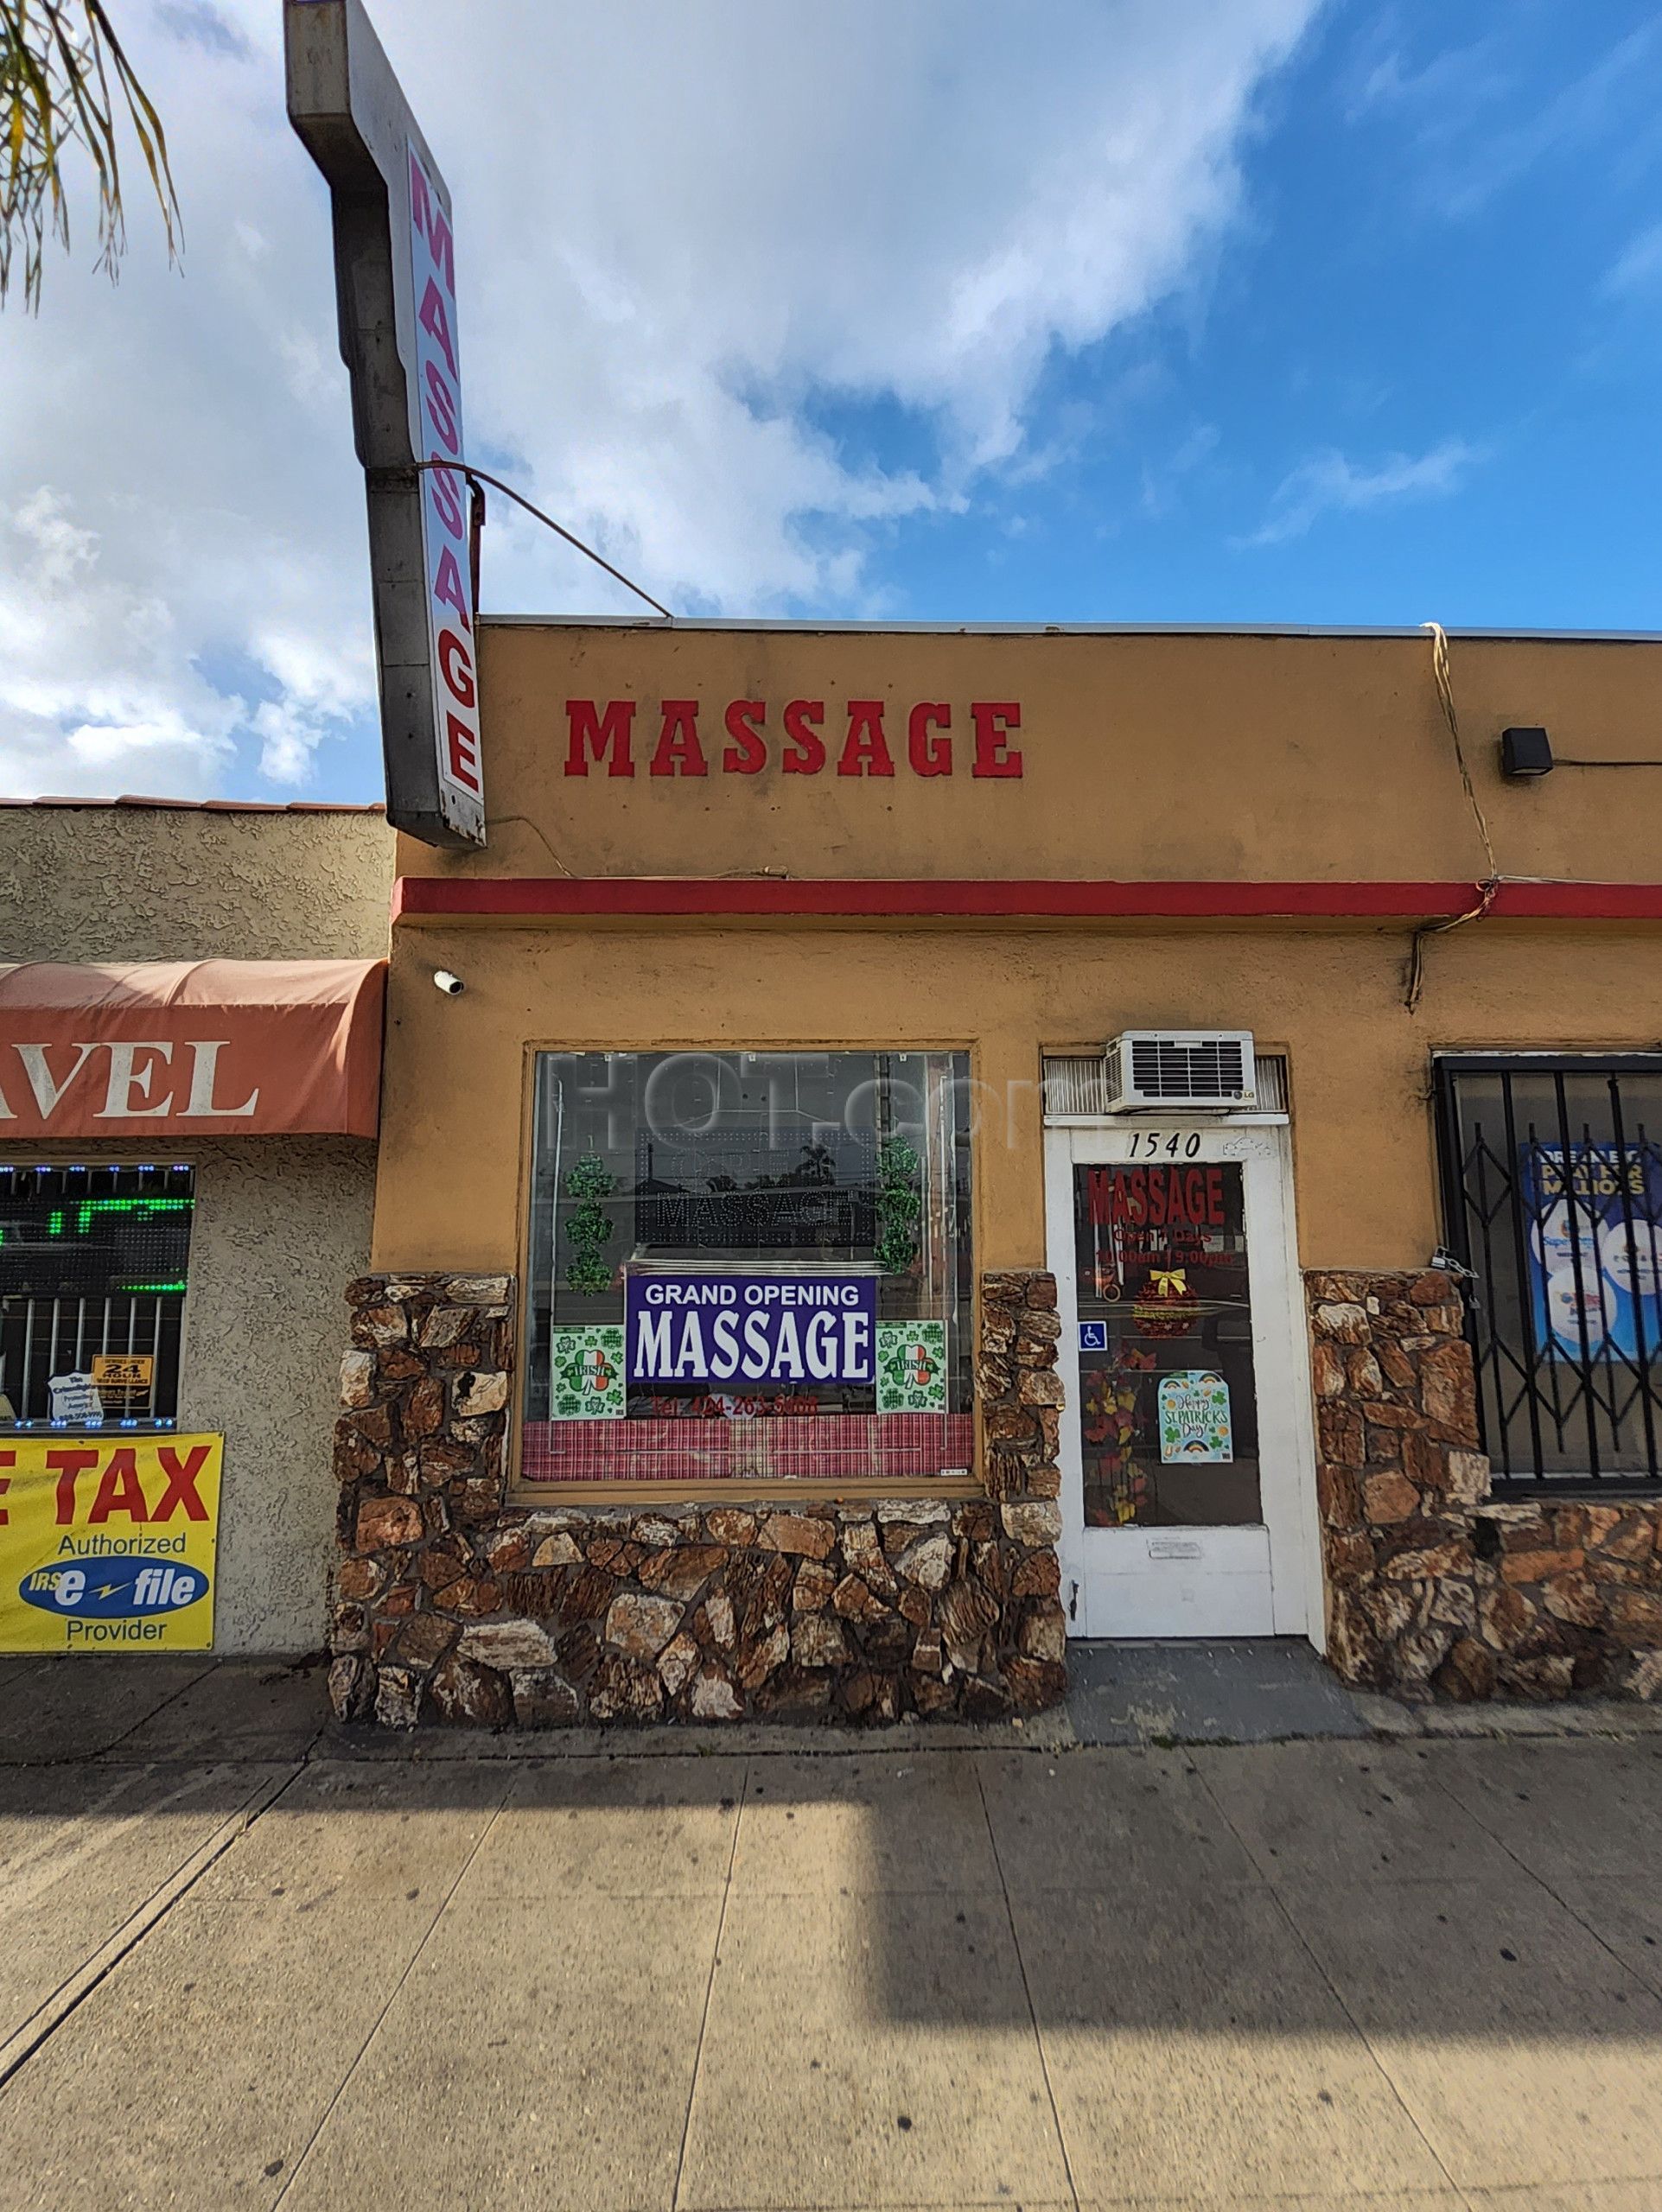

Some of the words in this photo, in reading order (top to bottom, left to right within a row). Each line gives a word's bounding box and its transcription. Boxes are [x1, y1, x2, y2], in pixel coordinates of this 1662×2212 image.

[408, 154, 480, 794] MASSAGE
[564, 700, 1022, 778] MASSAGE
[0, 1040, 259, 1120] VEL
[1130, 1133, 1200, 1158] 1540
[657, 1191, 853, 1227] MASSAGE
[1088, 1168, 1225, 1225] MASSAGE
[645, 1284, 736, 1305] GRAND
[743, 1285, 859, 1306] OPENING
[634, 1310, 869, 1379] MASSAGE
[105, 1363, 141, 1373] 24
[574, 1365, 605, 1376] IRISH
[895, 1360, 927, 1370] IRISH
[1176, 1394, 1210, 1410] Happy
[1182, 1422, 1208, 1438] Day!
[46, 1445, 213, 1526] TAX
[58, 1532, 186, 1555] Authorized
[29, 1572, 61, 1592] IRS
[132, 1568, 195, 1605] file
[67, 1619, 167, 1641] Provider
